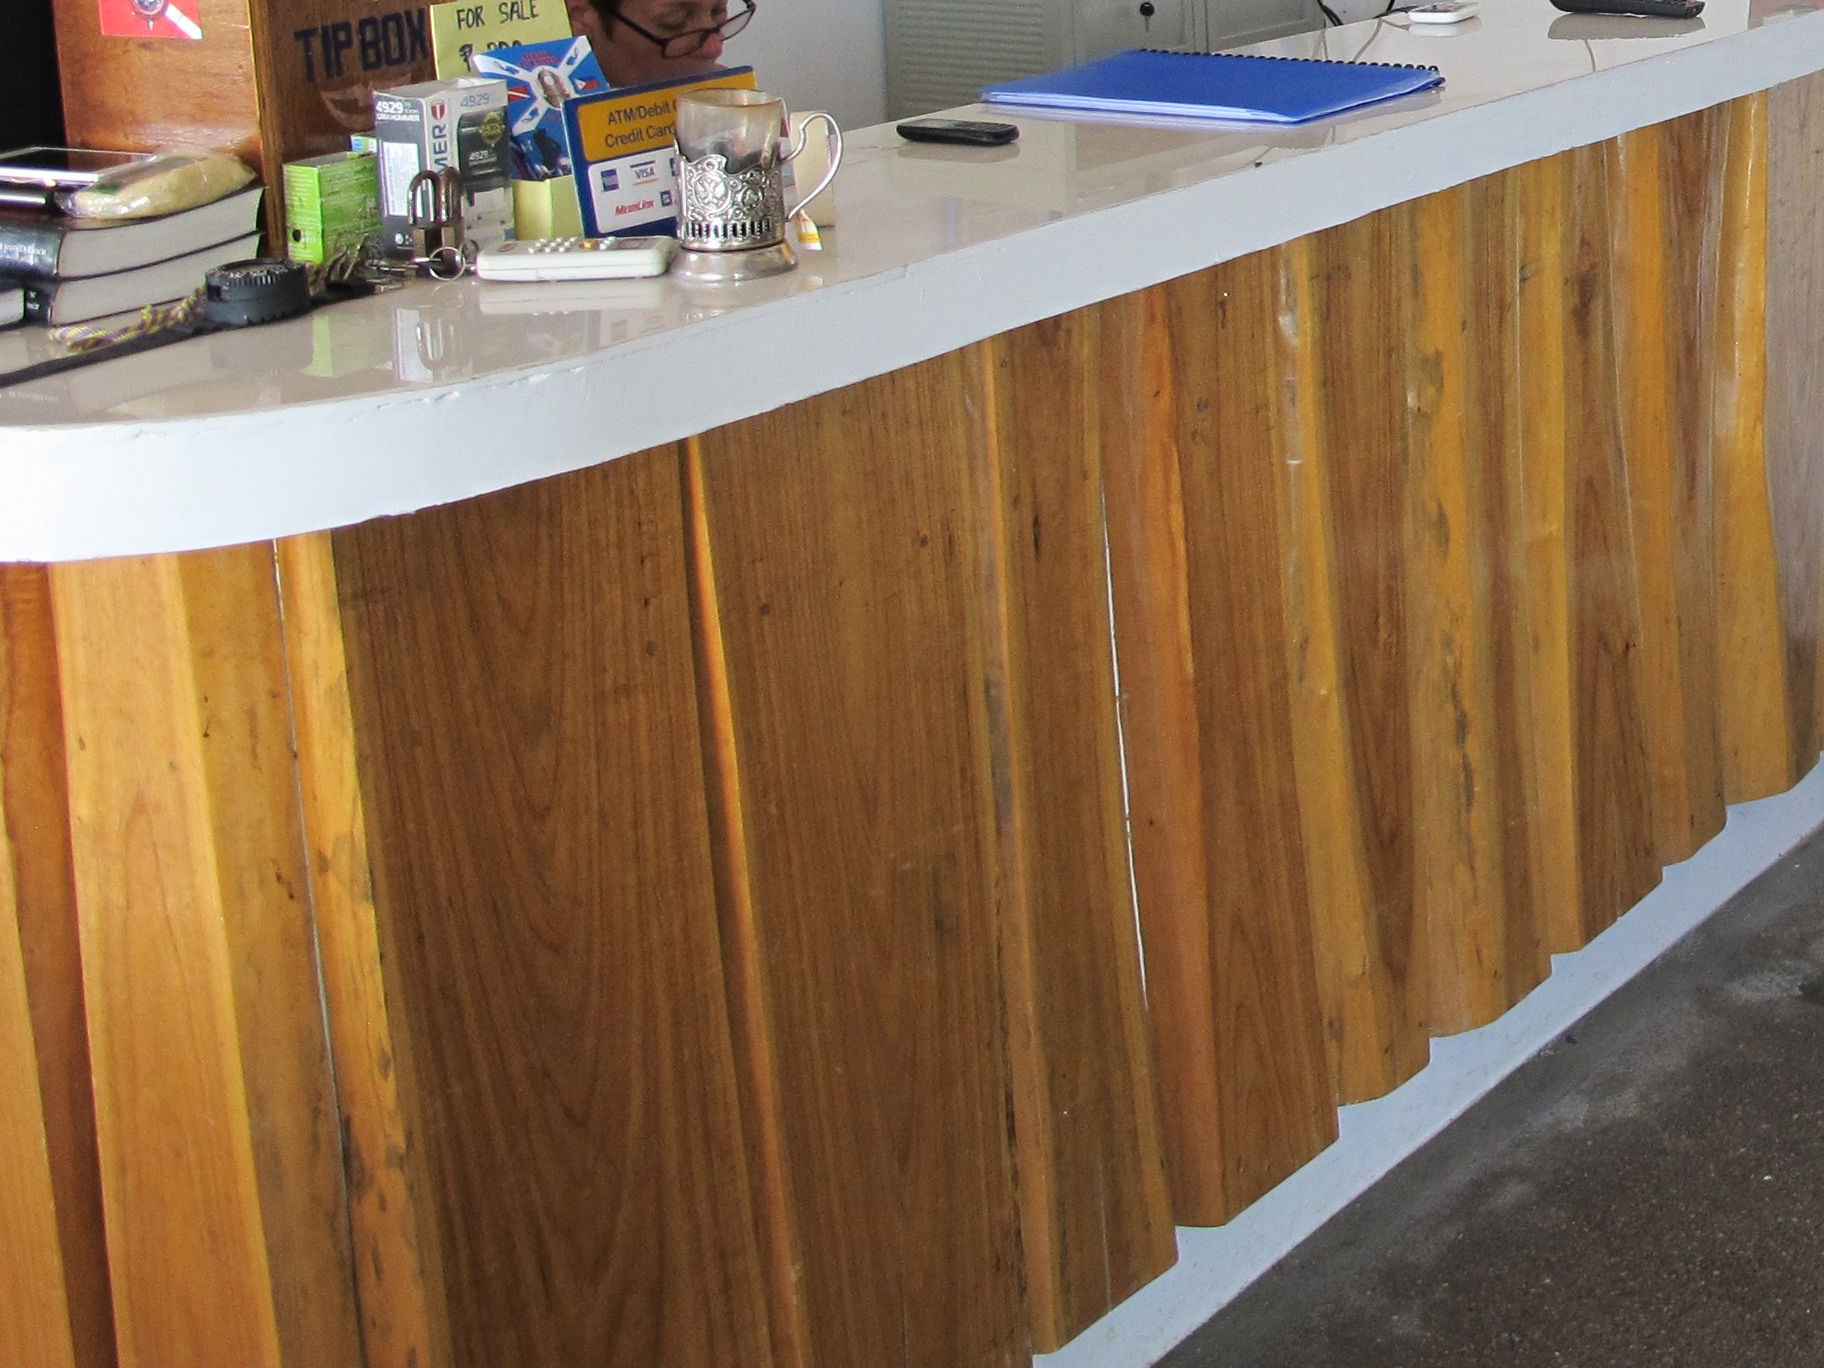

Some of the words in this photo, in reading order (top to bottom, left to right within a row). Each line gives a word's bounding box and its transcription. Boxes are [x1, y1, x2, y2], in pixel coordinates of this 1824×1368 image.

[457, 5, 485, 30] FOR
[293, 21, 352, 83] TIP
[359, 8, 428, 71] BOX
[375, 100, 404, 114] 4929
[460, 92, 489, 107] 4929
[608, 101, 671, 125] ATM/Debit
[605, 128, 644, 148] Credit
[634, 167, 655, 179] VISA
